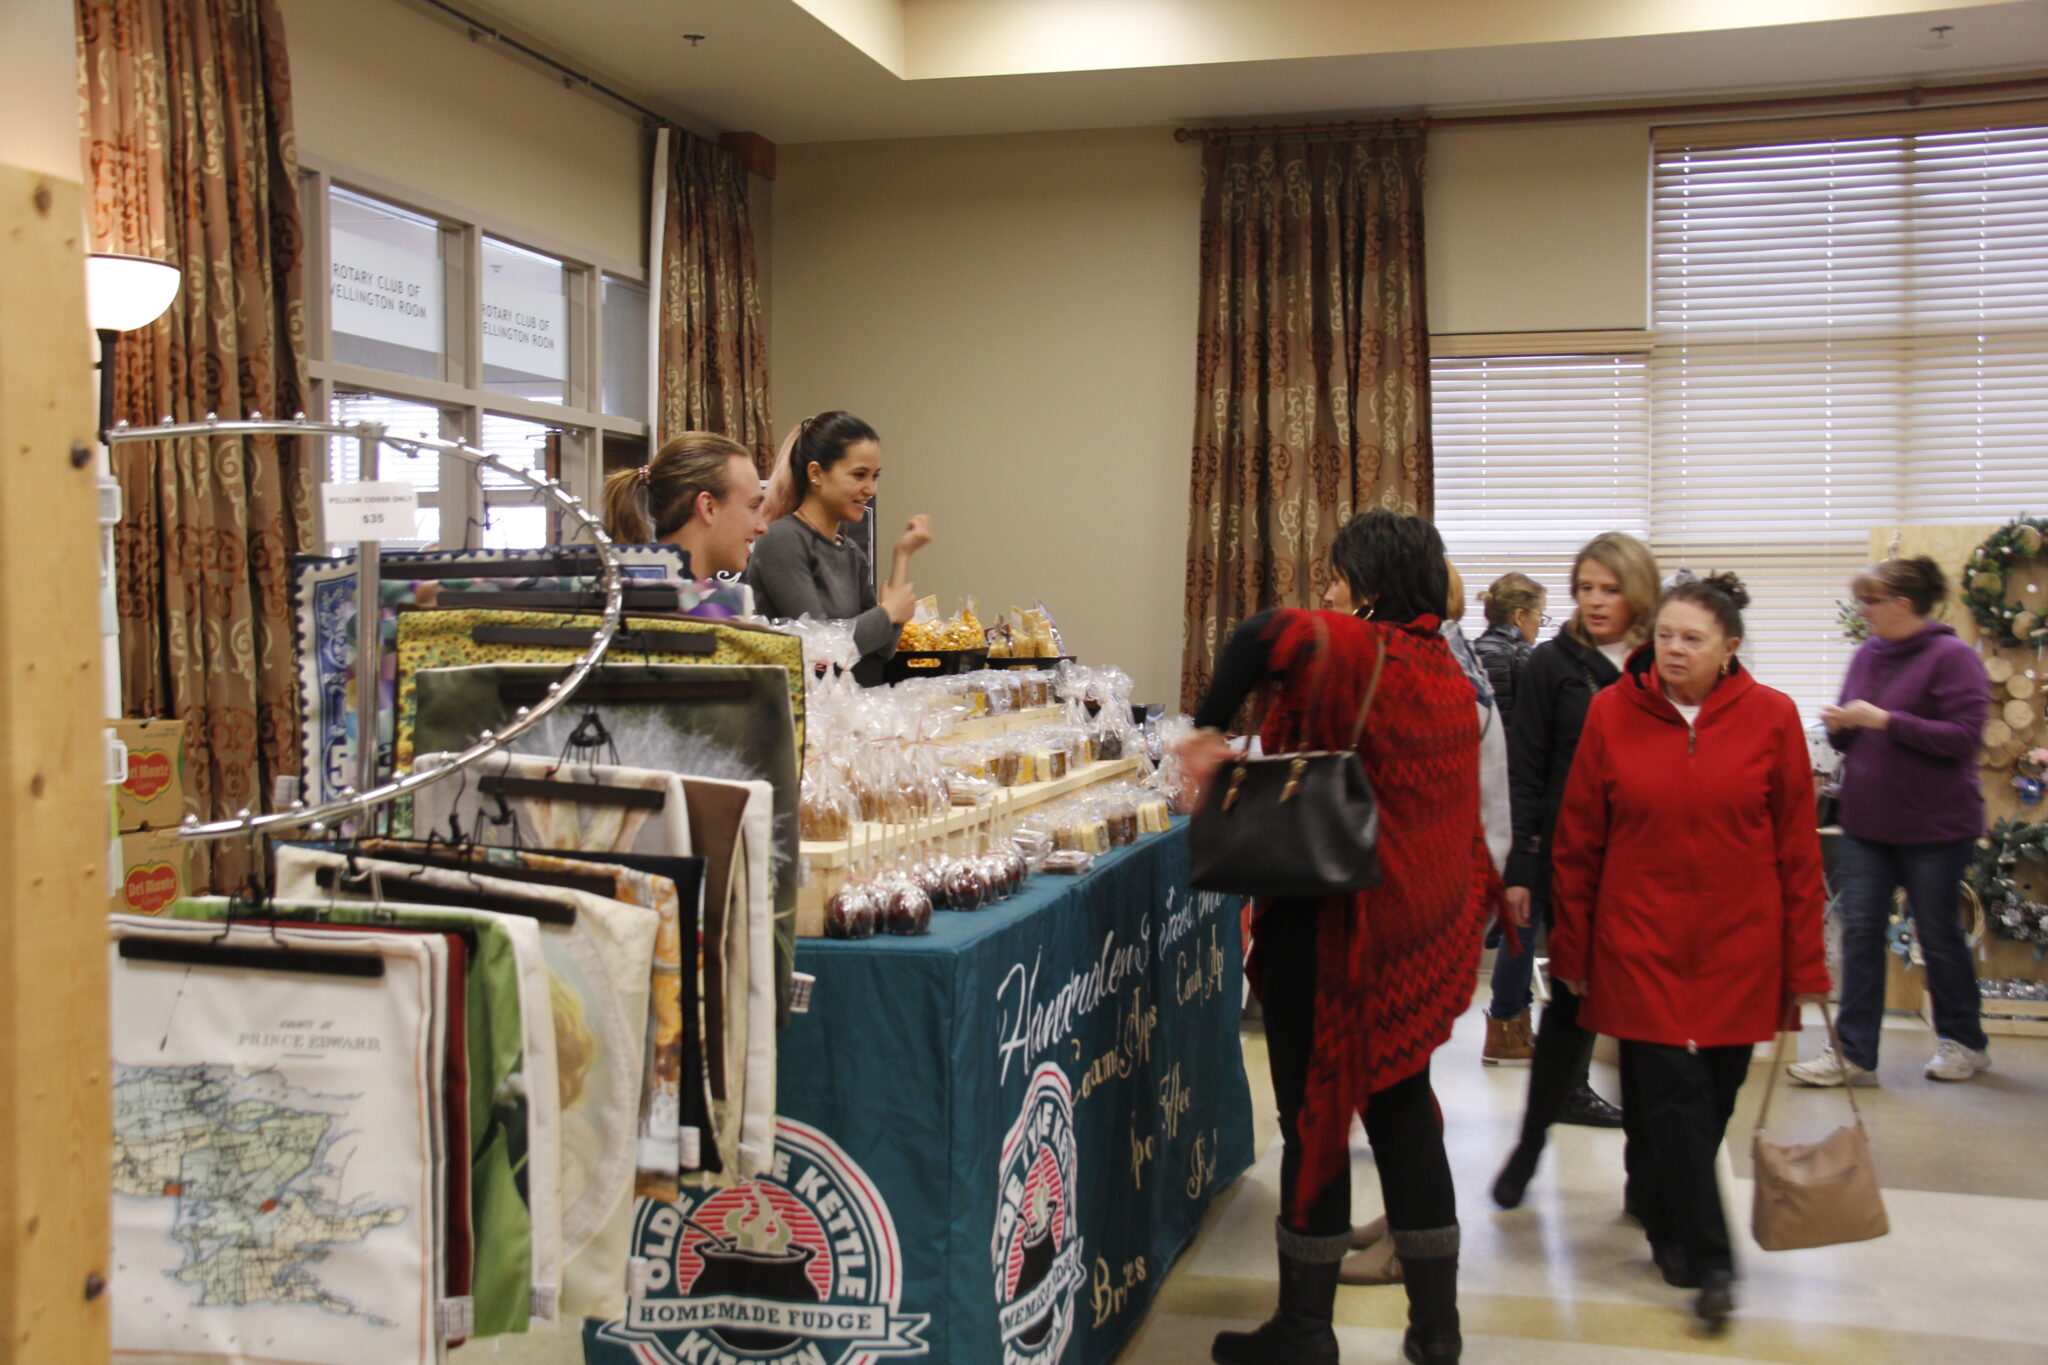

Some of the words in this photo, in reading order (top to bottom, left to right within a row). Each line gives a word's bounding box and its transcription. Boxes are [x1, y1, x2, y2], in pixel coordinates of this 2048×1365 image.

[333, 262, 374, 286] ROTARY
[377, 275, 404, 295] CLUB
[408, 283, 421, 299] OF
[399, 299, 427, 318] ROOM
[481, 303, 513, 322] ROTARY
[515, 311, 537, 329] CLUB
[539, 319, 550, 332] OF
[483, 320, 530, 344] ELLINGTON
[532, 333, 555, 350] ROOM
[329, 496, 362, 505] PILLOW
[364, 495, 391, 504] COVER
[392, 495, 413, 503] ONLY
[362, 513, 385, 525] $35
[238, 1032, 305, 1048] PRINCE
[308, 1034, 382, 1051] EDWARD
[644, 1191, 695, 1291] OLDE
[795, 1164, 867, 1300] KETTLE
[639, 1301, 781, 1325] HOMEMADE
[788, 1308, 872, 1331] FUDGE
